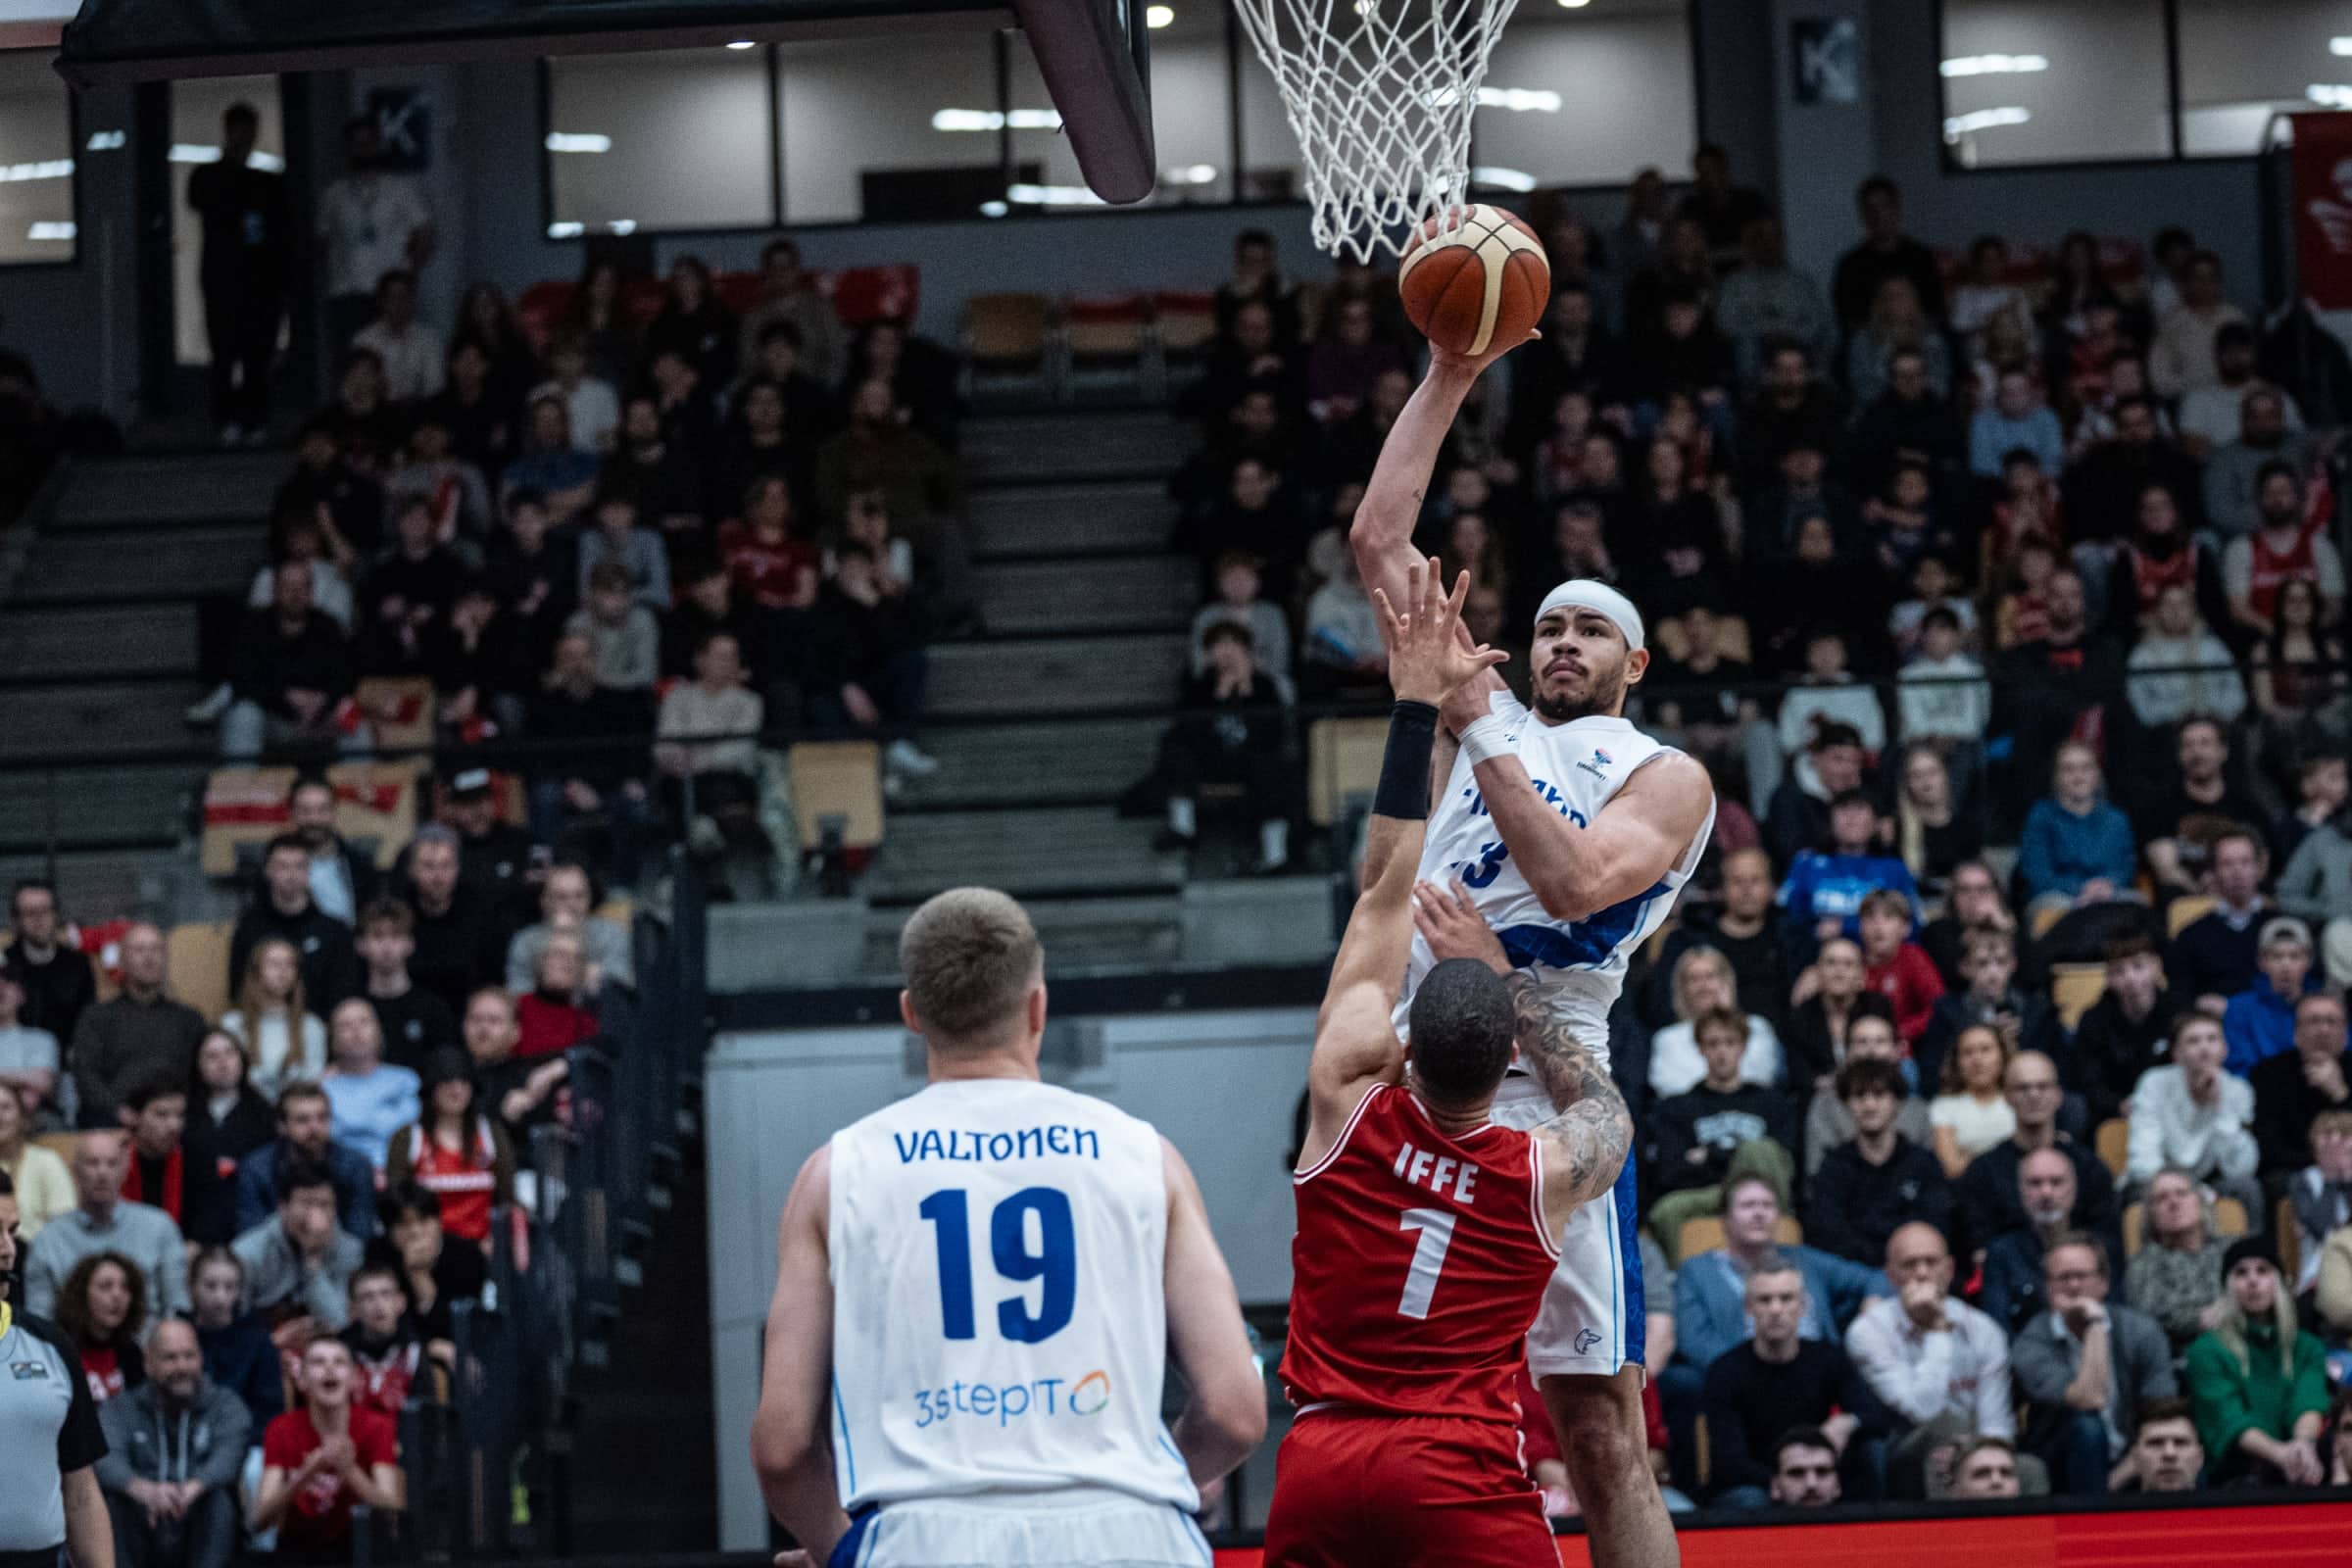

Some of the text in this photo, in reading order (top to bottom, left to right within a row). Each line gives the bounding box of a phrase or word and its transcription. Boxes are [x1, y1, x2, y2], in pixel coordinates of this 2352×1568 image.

[893, 1125, 1100, 1163] VALTONEN
[1393, 1141, 1480, 1204] IFFE
[918, 1186, 1076, 1346] 19
[1396, 1207, 1457, 1320] 1
